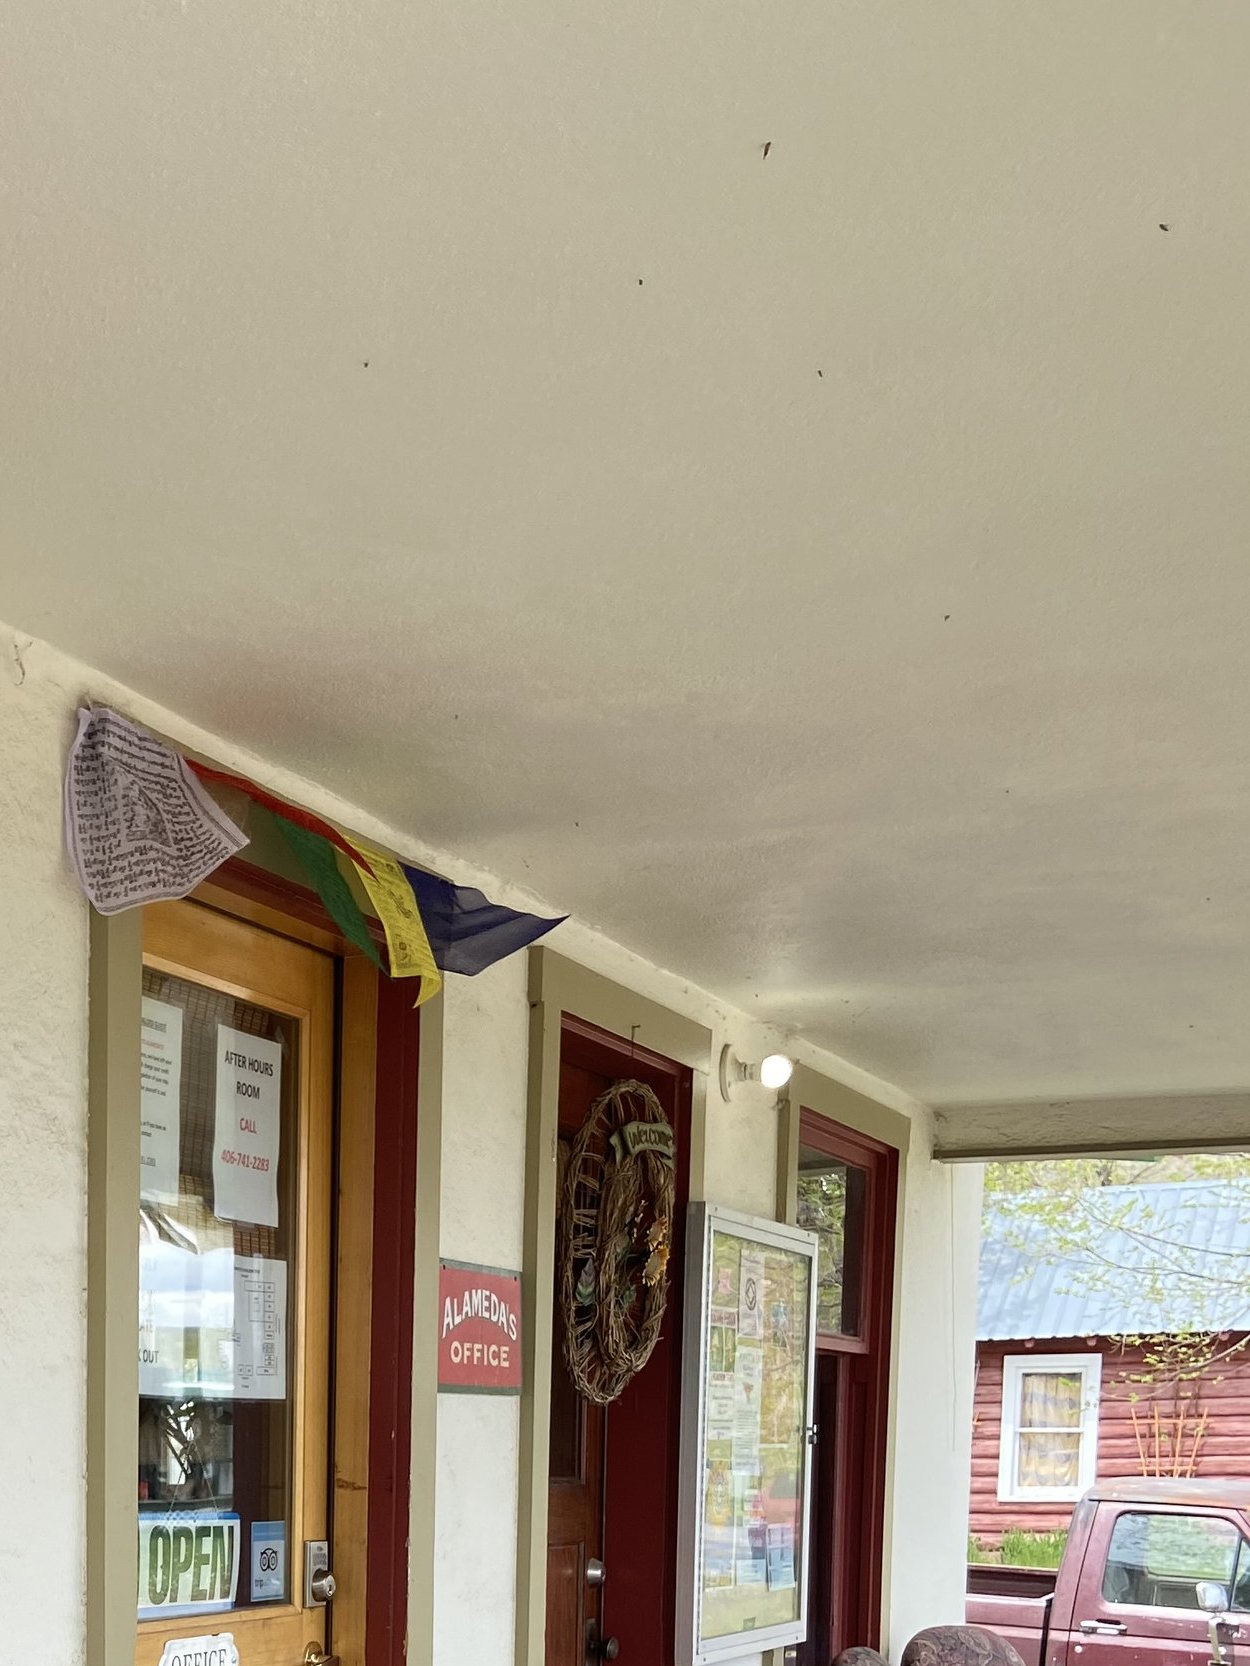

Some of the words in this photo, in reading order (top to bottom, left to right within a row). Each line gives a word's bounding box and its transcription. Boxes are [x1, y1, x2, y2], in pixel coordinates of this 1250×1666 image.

[224, 1049, 247, 1071] AFTER
[247, 1055, 274, 1077] HOURS
[236, 1081, 261, 1100] ROOM
[239, 1117, 257, 1135] CALL
[220, 1149, 270, 1172] 406-741-2283
[442, 1288, 518, 1341] ALAMEDA'S
[142, 1348, 159, 1364] OUT
[450, 1340, 510, 1368] OFFICE
[148, 1525, 234, 1606] OPEN
